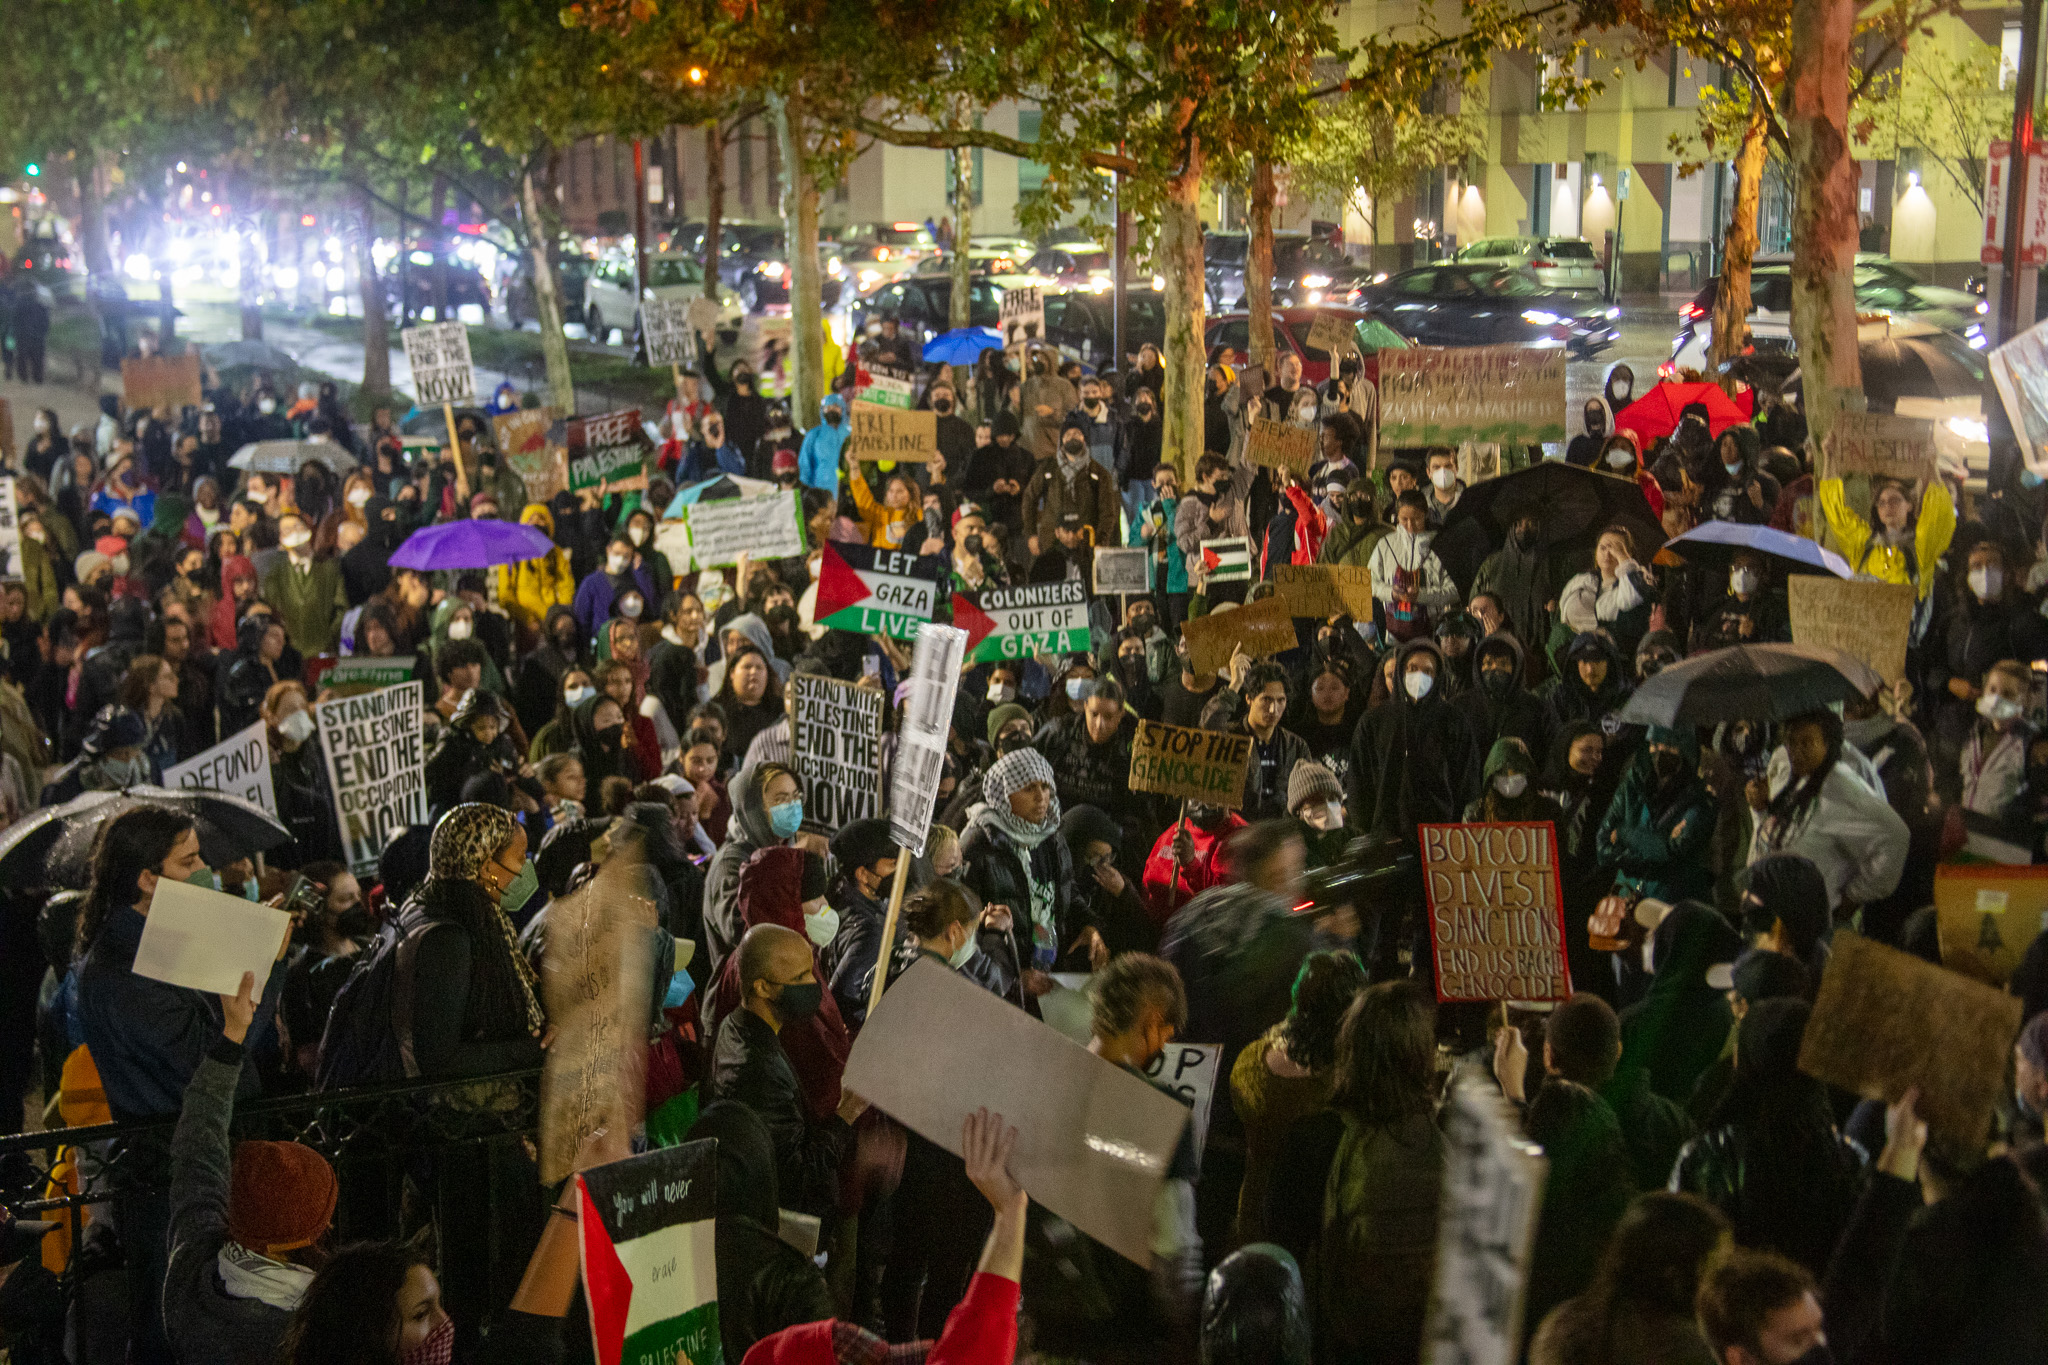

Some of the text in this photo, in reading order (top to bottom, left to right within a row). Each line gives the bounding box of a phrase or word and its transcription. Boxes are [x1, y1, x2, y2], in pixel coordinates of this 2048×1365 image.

[1003, 287, 1039, 309] FREE
[416, 374, 473, 403] NOW!
[585, 416, 630, 448] FREE
[856, 412, 897, 434] FREE
[1841, 415, 1884, 434] FREE
[852, 433, 930, 456] PALESTINE
[571, 443, 643, 486] PALESTINE
[873, 549, 917, 576] LET
[1274, 566, 1371, 586] BOMBING KIDS
[876, 583, 928, 610] GAZA
[980, 582, 1083, 610] COLONIZERS
[861, 608, 919, 638] LIVE
[1008, 608, 1074, 630] OUT OF
[1001, 631, 1072, 658] GAZA
[322, 685, 419, 728] STAND WITH
[795, 677, 879, 712] STAND WITH
[328, 708, 420, 753] PALESTINE!
[795, 698, 879, 738] PALESTINE!
[795, 722, 878, 770] END THE
[1142, 723, 1248, 763] STOP THE
[180, 739, 263, 791] DEFUND
[334, 733, 420, 788] END THE
[792, 754, 878, 793] OCCUPATION
[1133, 754, 1237, 793] GENOCIDE
[339, 768, 422, 813] OCCUPATION
[346, 791, 421, 861] NOW!
[1423, 826, 1549, 866] BOYCOTT
[1428, 869, 1553, 908] DIVEST
[1434, 906, 1562, 948] SANCTIONS
[1437, 949, 1482, 974] END
[1486, 949, 1513, 976] US
[1440, 974, 1562, 999] GENOCIDE
[641, 1178, 658, 1206] will
[664, 1178, 692, 1204] never
[652, 1256, 677, 1283] erase
[639, 1326, 708, 1365] PALESTINE
